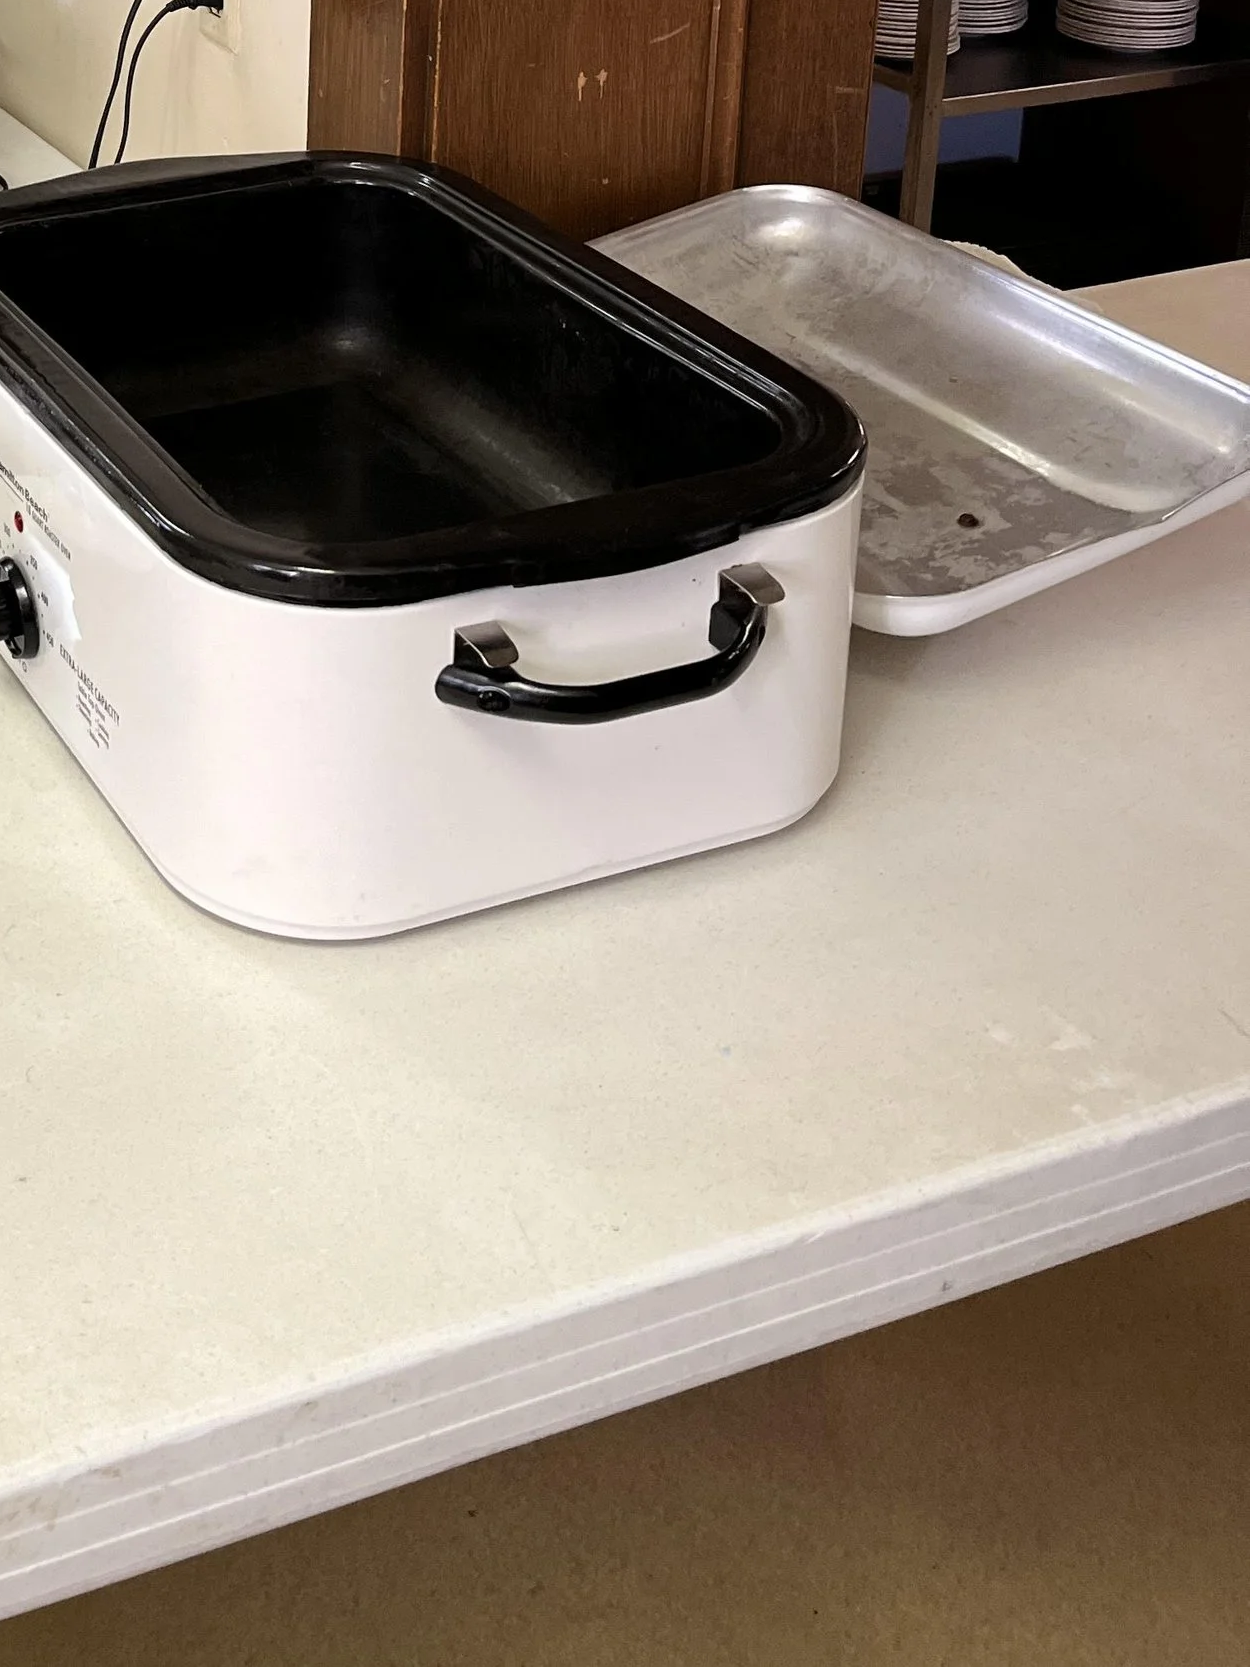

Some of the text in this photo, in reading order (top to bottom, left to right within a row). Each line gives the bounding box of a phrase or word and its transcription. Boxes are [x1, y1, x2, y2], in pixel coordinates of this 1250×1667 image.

[24, 488, 48, 522] Beach
[60, 643, 94, 694] EXTRA-LARGE
[94, 687, 120, 727] CAPACITY
